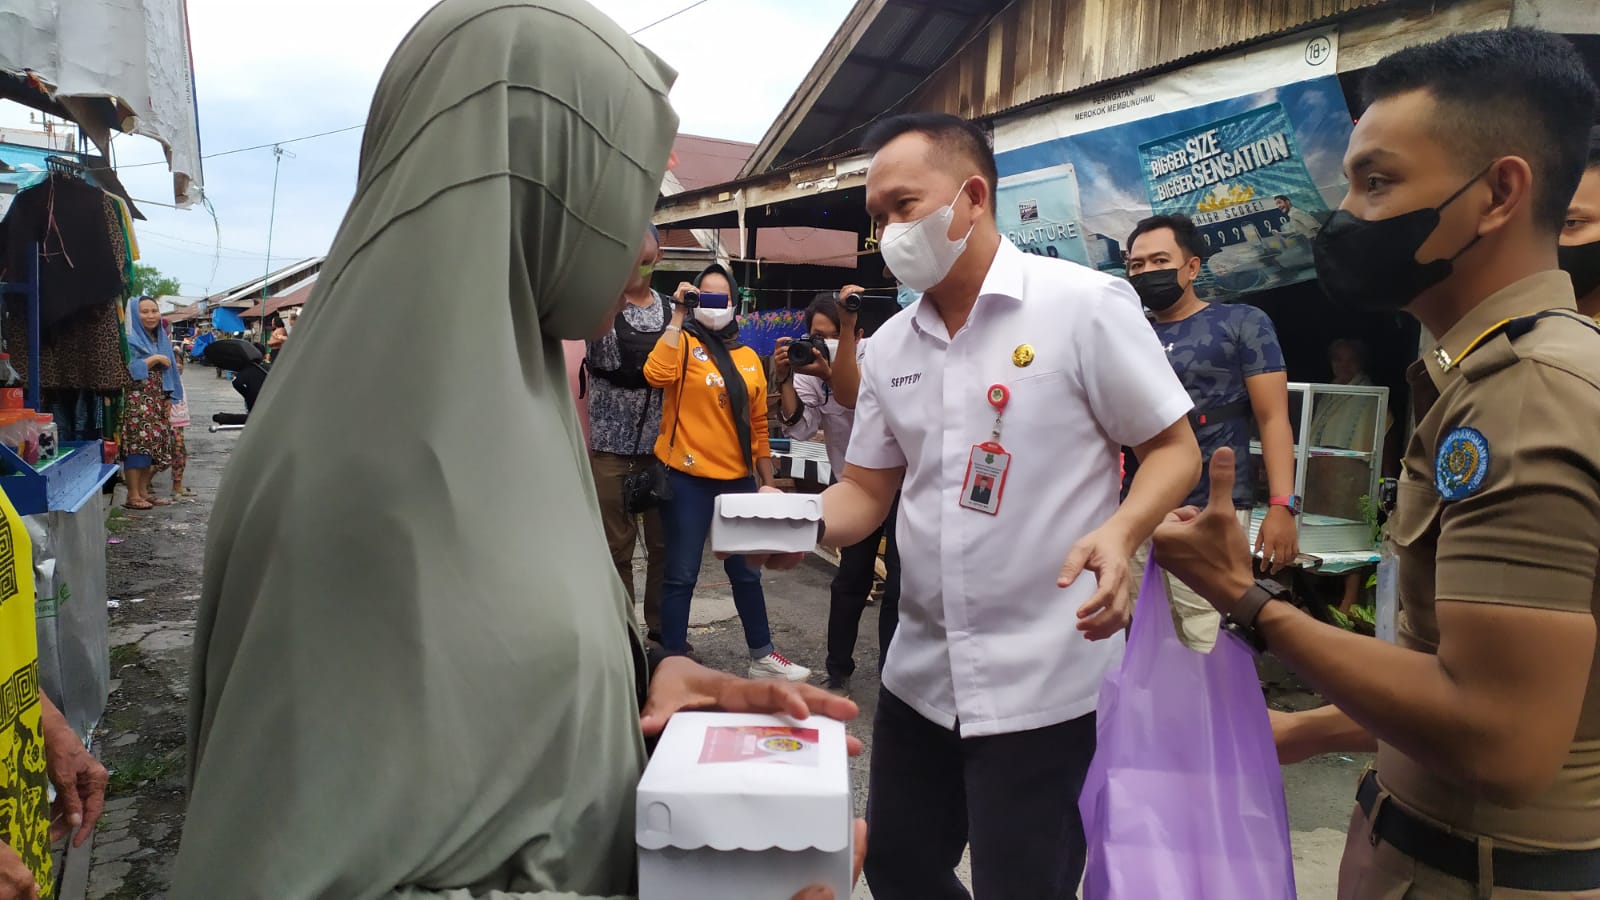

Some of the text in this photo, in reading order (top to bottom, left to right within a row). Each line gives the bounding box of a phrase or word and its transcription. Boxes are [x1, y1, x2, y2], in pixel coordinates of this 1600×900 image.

[1309, 43, 1327, 59] 18+
[1074, 94, 1156, 121] MEROKOK MEMBUNUHMU
[1150, 128, 1221, 178] BIGGER SIZE
[1157, 131, 1289, 201] BIGGER SENSATION
[1007, 221, 1078, 246] GNATURE
[890, 371, 922, 388] SEPTEDY
